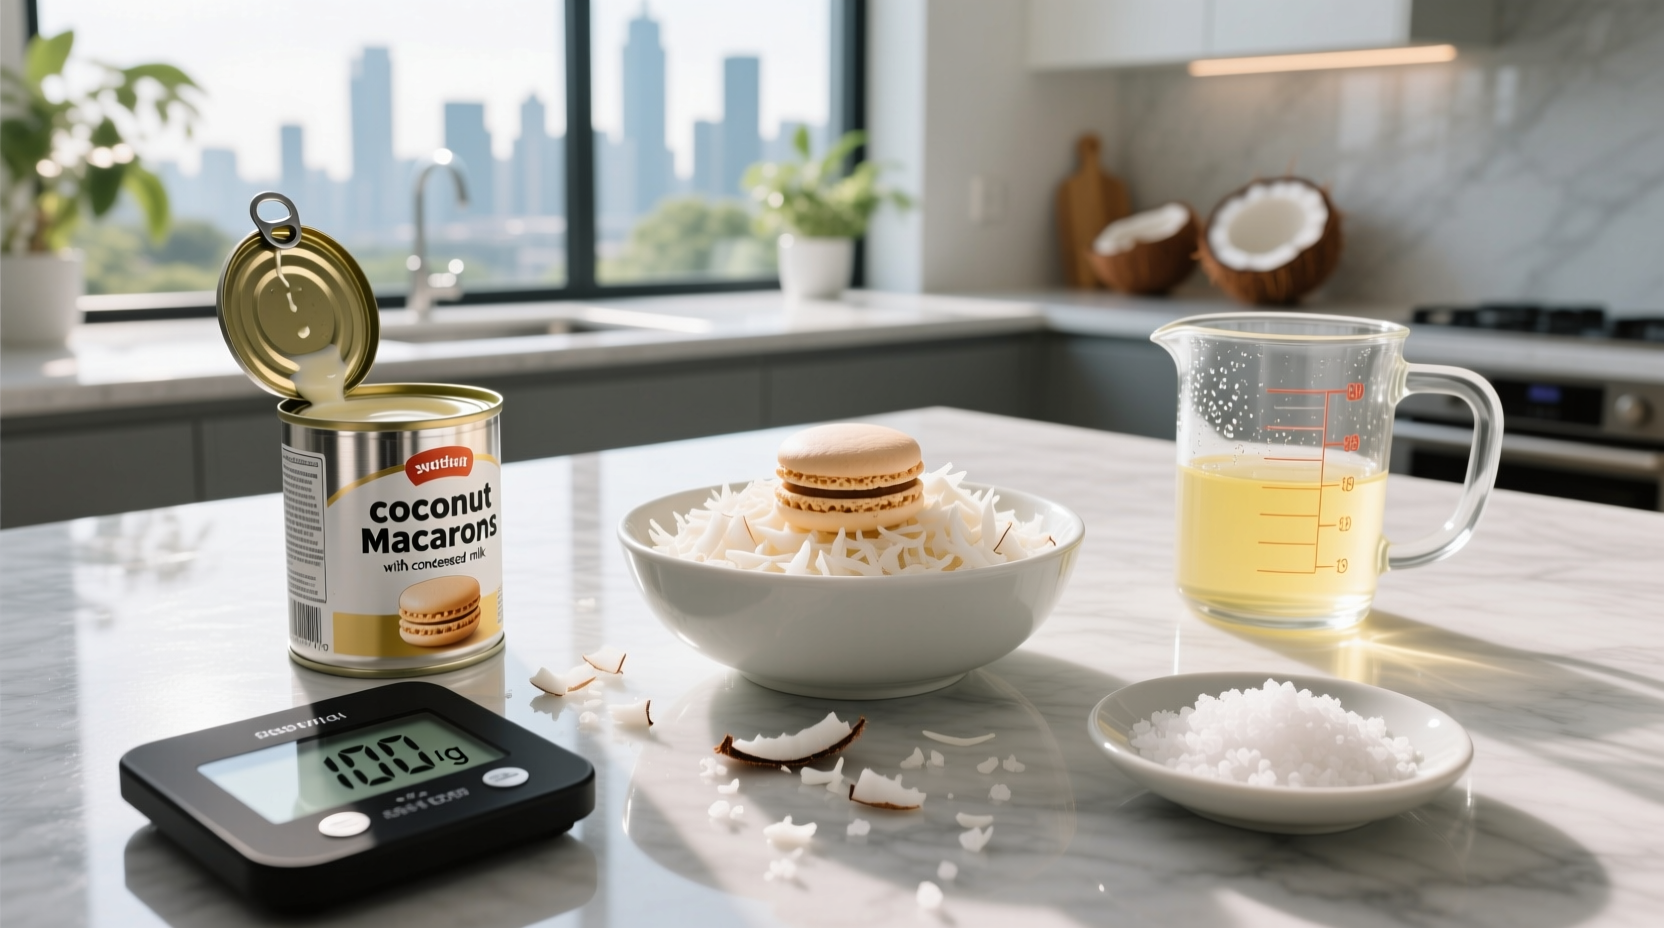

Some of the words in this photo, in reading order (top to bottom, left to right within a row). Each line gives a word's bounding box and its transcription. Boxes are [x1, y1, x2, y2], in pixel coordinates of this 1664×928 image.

[369, 482, 492, 524] coconut
[361, 513, 497, 554] Macarons
[383, 558, 409, 573] with
